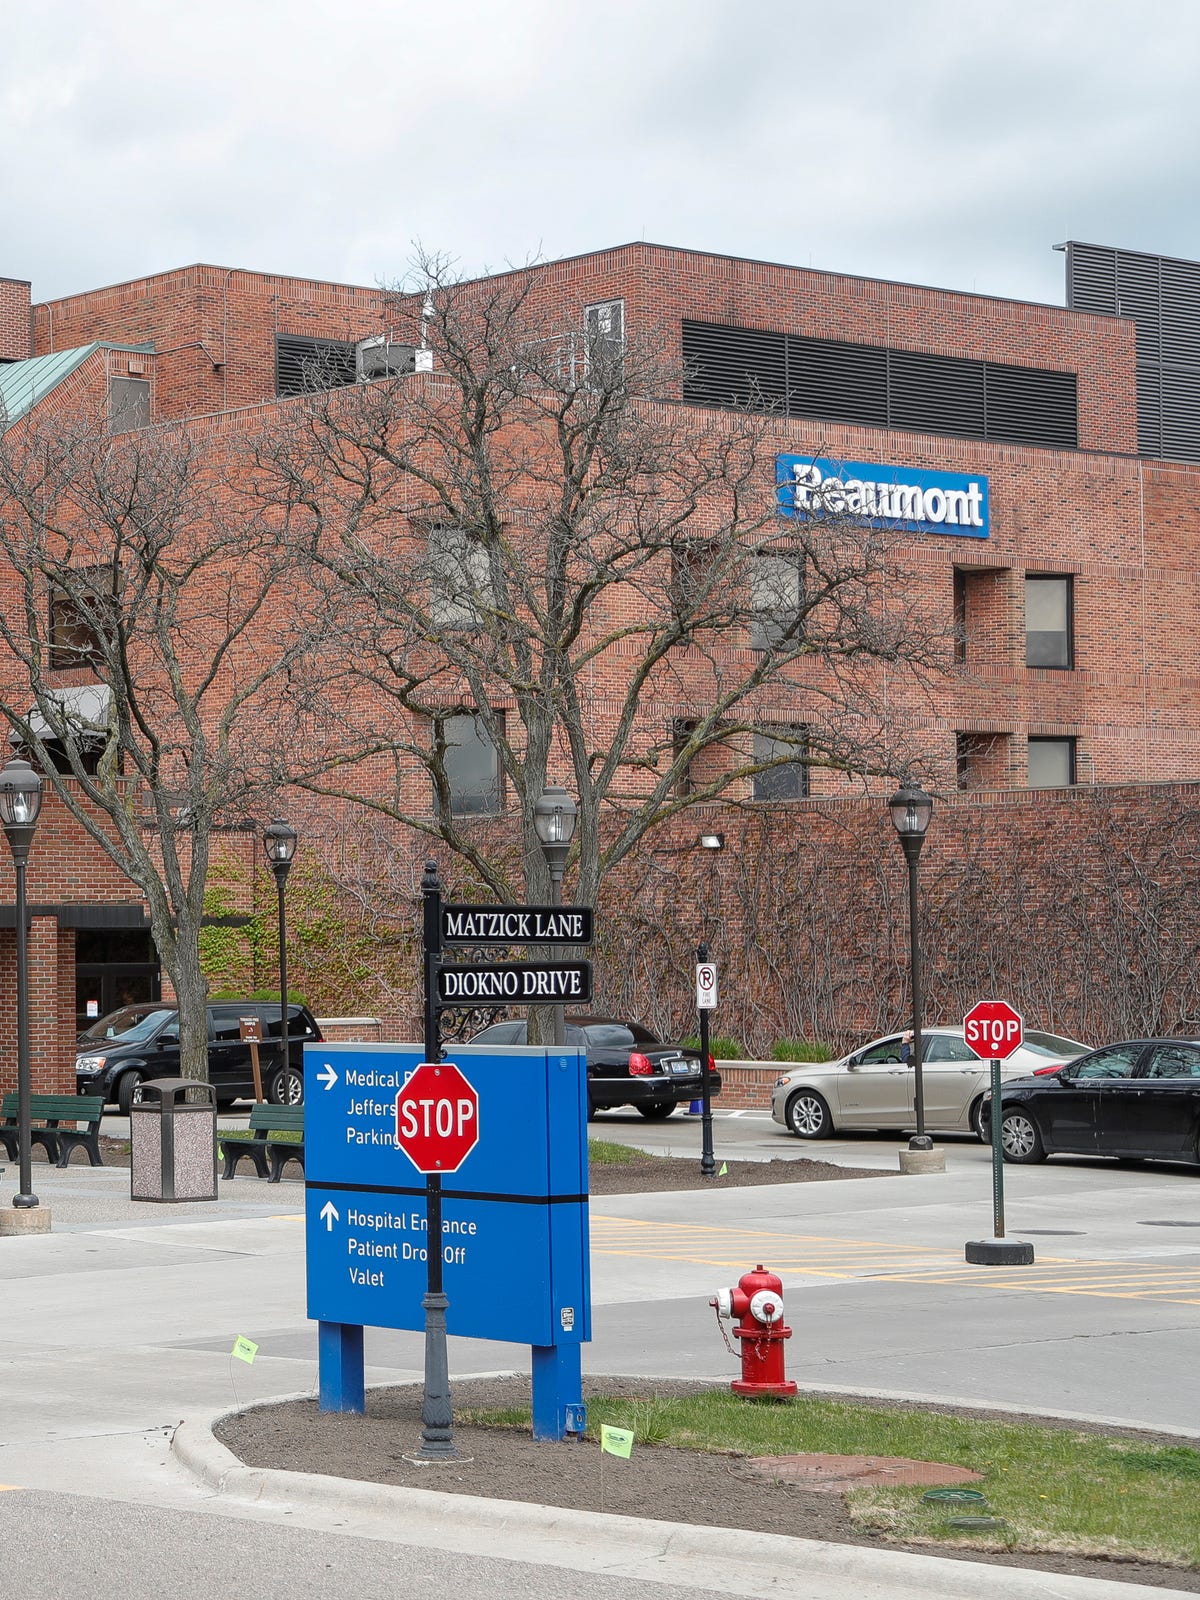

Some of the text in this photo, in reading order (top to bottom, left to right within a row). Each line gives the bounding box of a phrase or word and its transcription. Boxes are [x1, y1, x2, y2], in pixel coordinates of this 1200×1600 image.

[793, 463, 984, 528] Beaumont
[446, 913, 583, 937] MATZICK LANE
[444, 971, 581, 996] DIOKNO DRIVE
[967, 1019, 1019, 1041] STOP
[345, 1069, 400, 1088] Medical
[401, 1098, 474, 1138] STOP
[348, 1208, 477, 1235] Hospital Enance
[348, 1238, 398, 1259] Patient
[349, 1267, 384, 1287] Valet
